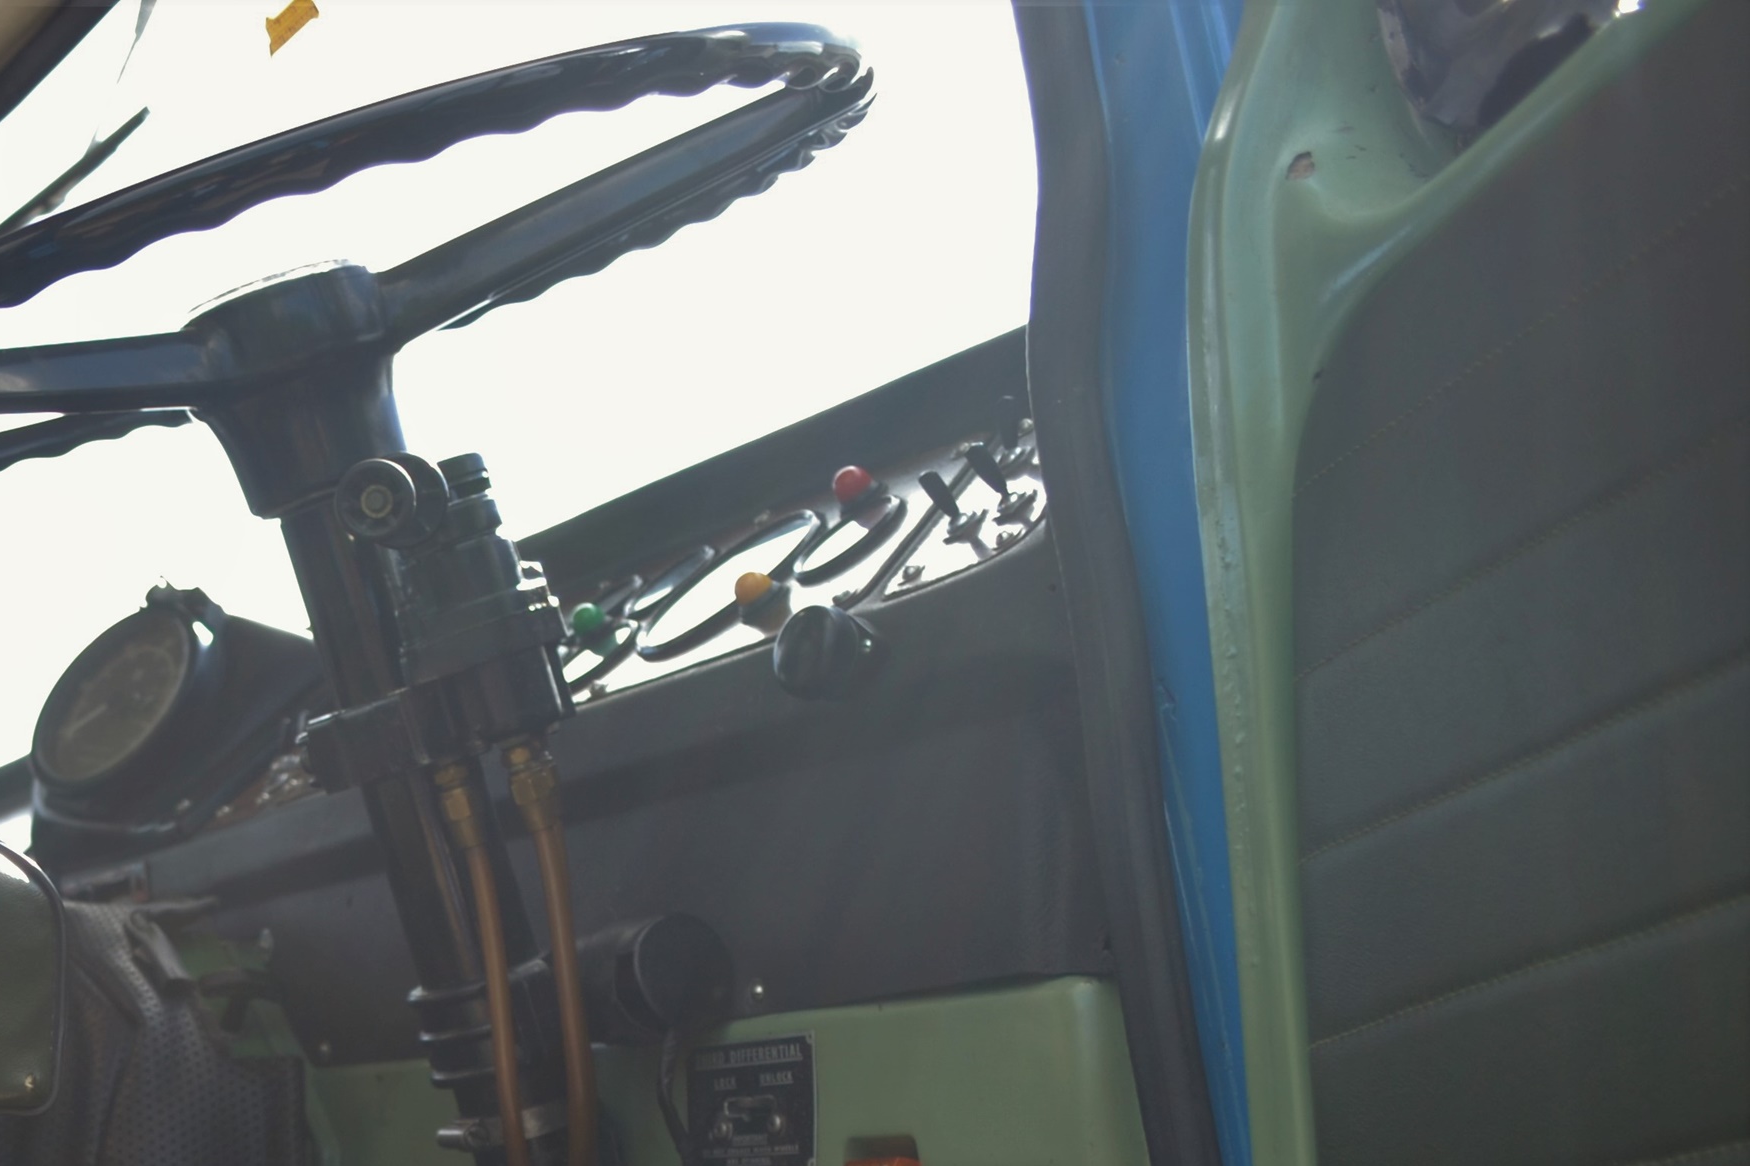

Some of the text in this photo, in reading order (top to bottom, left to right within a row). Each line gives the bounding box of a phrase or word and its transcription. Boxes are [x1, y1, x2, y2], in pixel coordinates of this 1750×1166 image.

[730, 1043, 803, 1065] DIFFERENTIAL
[714, 1071, 793, 1089] LOCK UNLOCK
